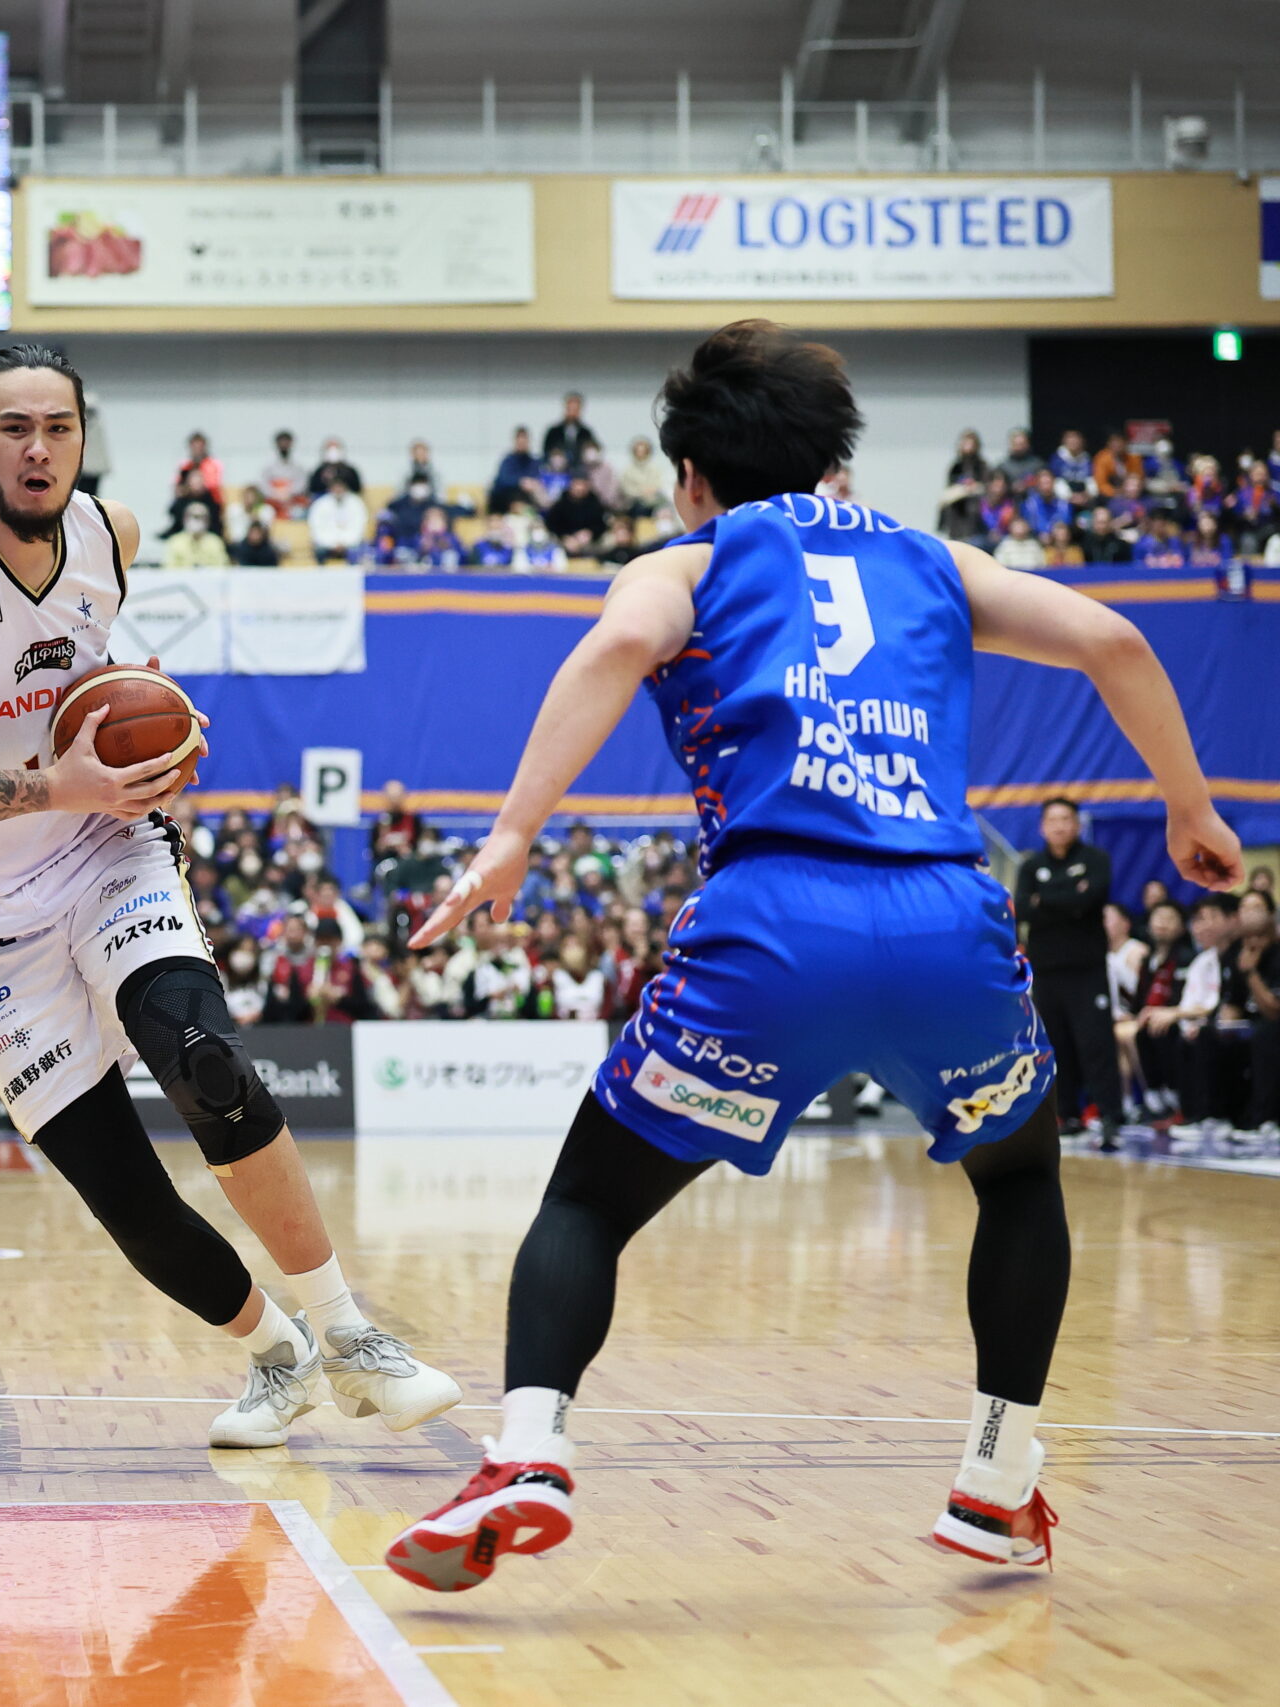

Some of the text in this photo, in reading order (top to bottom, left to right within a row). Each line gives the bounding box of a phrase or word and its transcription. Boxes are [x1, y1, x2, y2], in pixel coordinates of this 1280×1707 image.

[736, 197, 1072, 249] LOGISTEED
[803, 552, 875, 676] 3
[16, 641, 75, 678] ALPHAS
[785, 663, 928, 745] HAGAWA
[318, 767, 346, 805] P
[790, 752, 938, 822] HONDA
[4, 1039, 72, 1105] 武蔵野銀行
[260, 1061, 341, 1098] Bank
[670, 1084, 766, 1128] SOMENO
